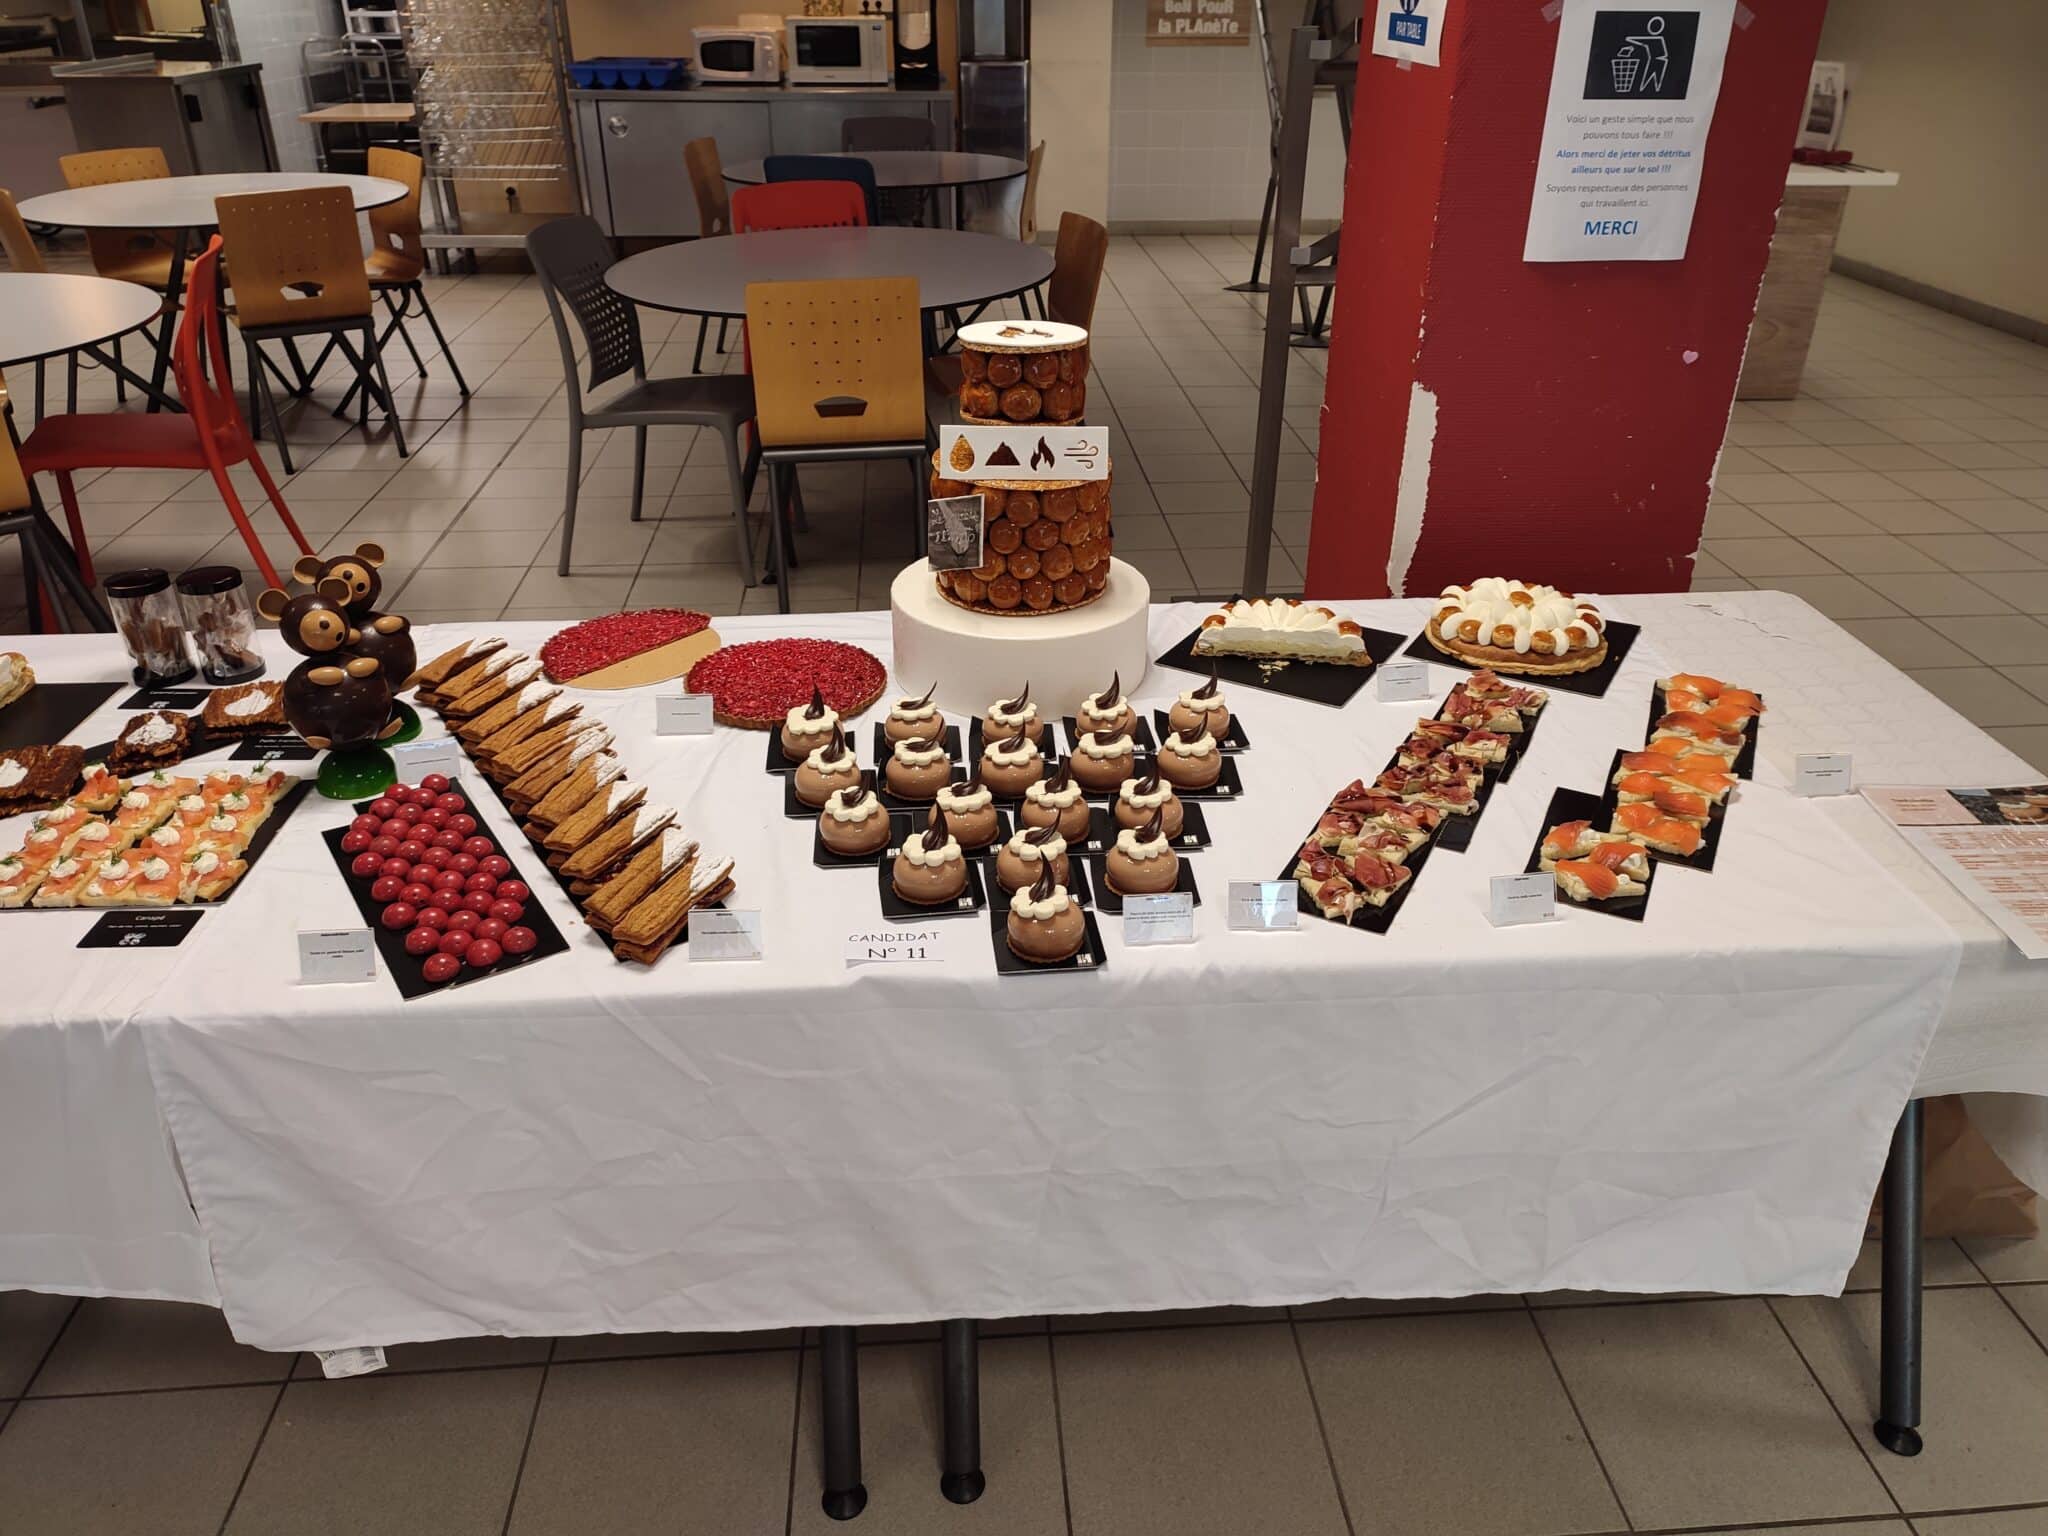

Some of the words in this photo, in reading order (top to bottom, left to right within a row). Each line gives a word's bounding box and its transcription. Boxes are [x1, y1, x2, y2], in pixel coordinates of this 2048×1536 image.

[1395, 20, 1406, 36] PAR
[1407, 22, 1422, 39] TABLE
[1566, 114, 1588, 123] Voici
[1589, 115, 1600, 124] un
[1601, 115, 1626, 126] geste
[1627, 115, 1655, 124] simple
[1656, 115, 1673, 125] que
[1674, 115, 1694, 124] nous
[1583, 131, 1619, 141] pouvons
[1620, 131, 1640, 140] tous
[1641, 130, 1662, 140] faire
[1556, 149, 1579, 158] Alors
[1580, 149, 1606, 158] merci
[1607, 149, 1619, 158] de
[1619, 149, 1641, 160] jeter
[1642, 150, 1657, 158] vos
[1658, 147, 1692, 158] détritus
[1571, 165, 1602, 174] ailleurs
[1605, 166, 1621, 176] que
[1623, 166, 1637, 174] sur
[1638, 165, 1646, 173] le
[1647, 165, 1660, 173] sol
[1546, 183, 1577, 194] Soyons
[1578, 184, 1629, 194] respectueux
[1630, 183, 1645, 192] des
[1646, 184, 1689, 193] personnes
[1580, 200, 1594, 209] qui
[1595, 199, 1638, 208] travaillent
[1584, 220, 1639, 236] MERCI
[848, 931, 941, 943] CANDIDAT
[868, 947, 897, 959] N°
[906, 947, 928, 959] 11
